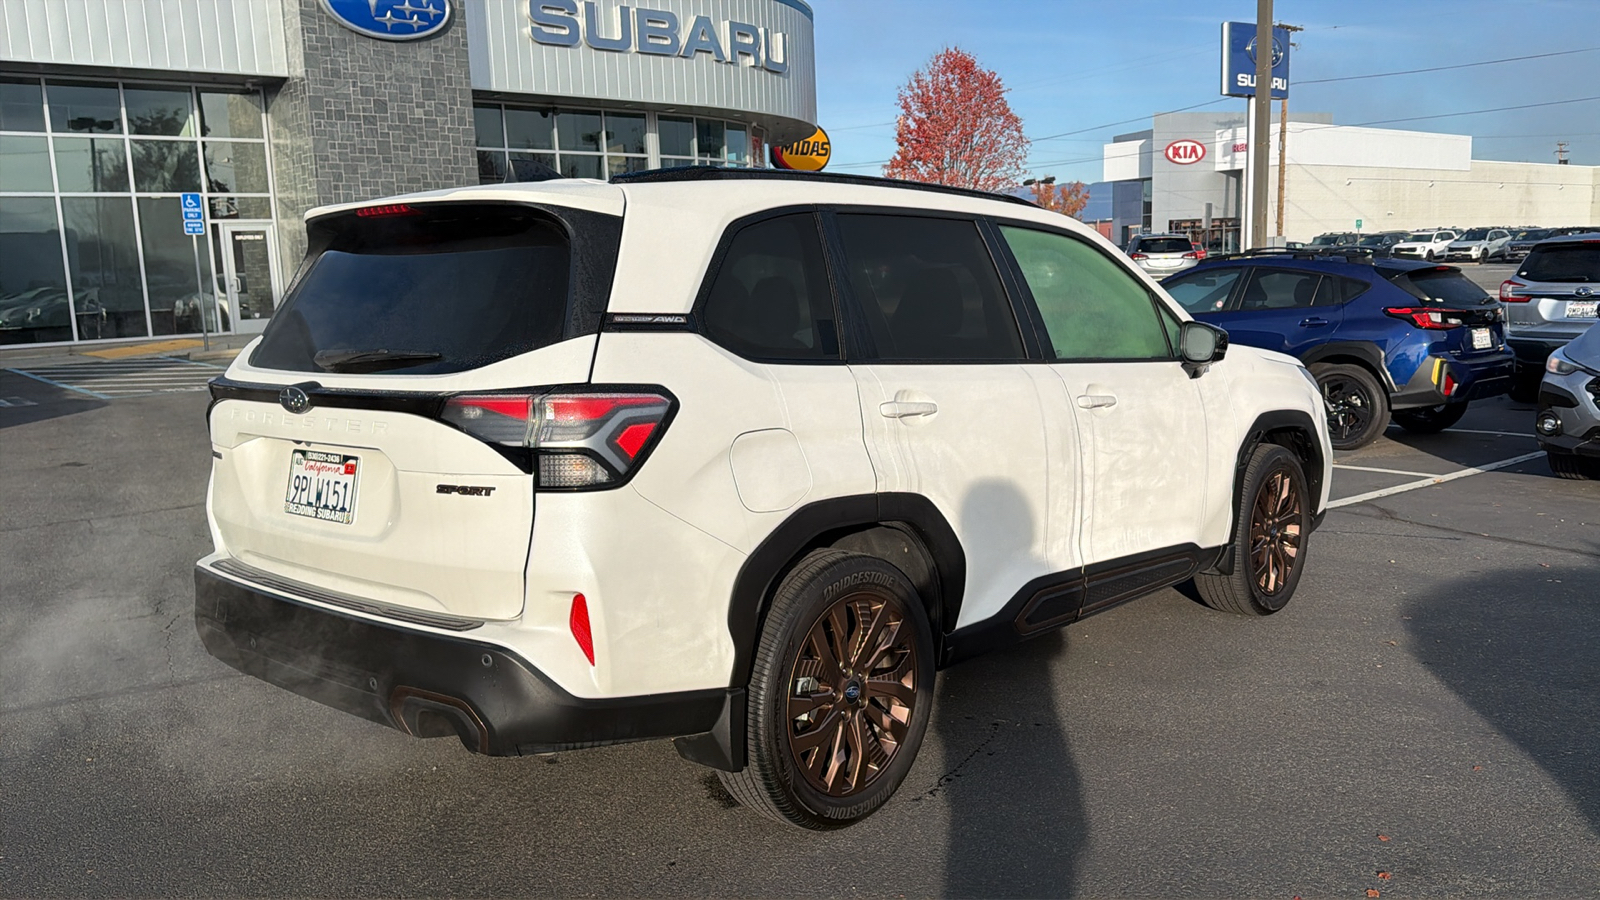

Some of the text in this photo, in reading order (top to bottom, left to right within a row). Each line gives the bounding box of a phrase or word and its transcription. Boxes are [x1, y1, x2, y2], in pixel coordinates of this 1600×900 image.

[528, 0, 790, 73] SUBARU
[1237, 73, 1287, 90] SURU
[780, 140, 829, 157] MIDAS
[1171, 145, 1200, 159] KIA
[230, 408, 389, 435] FORESTER
[305, 459, 346, 476] California
[290, 474, 348, 512] 9PLW151
[435, 484, 496, 497] SPORT
[289, 503, 344, 522] REDDING SUBARU
[823, 571, 895, 603] BRIDGESTONE
[824, 780, 896, 820] BRIDGESTONE
